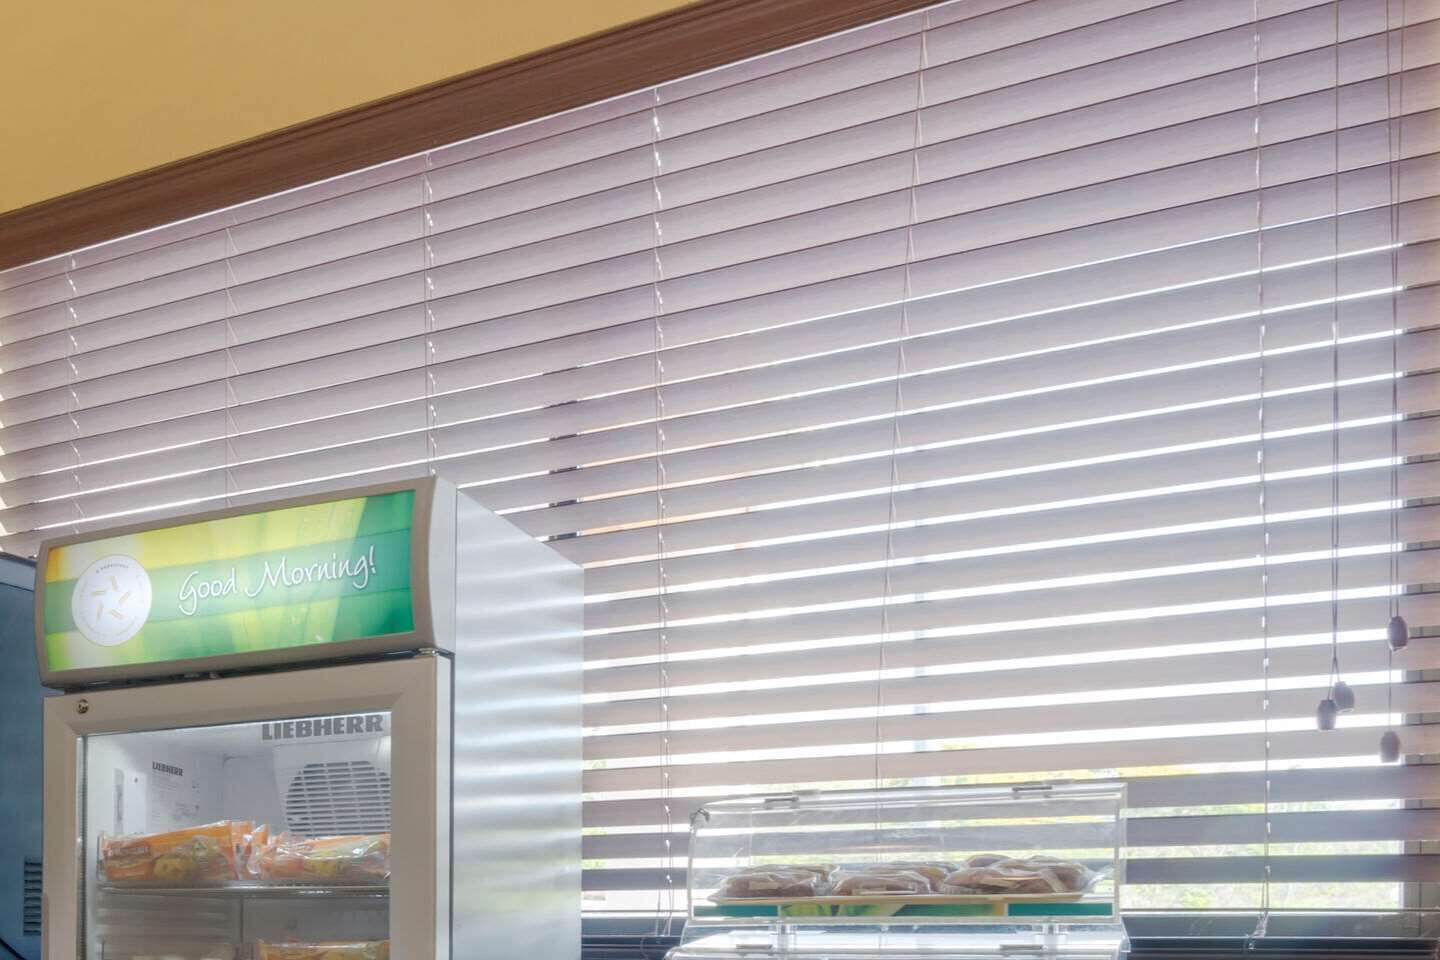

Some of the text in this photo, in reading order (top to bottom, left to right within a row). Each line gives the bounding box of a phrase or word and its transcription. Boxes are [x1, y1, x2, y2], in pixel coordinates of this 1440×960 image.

[179, 568, 239, 616] Good
[245, 546, 376, 597] Morning!
[262, 714, 384, 740] LIEBHERR
